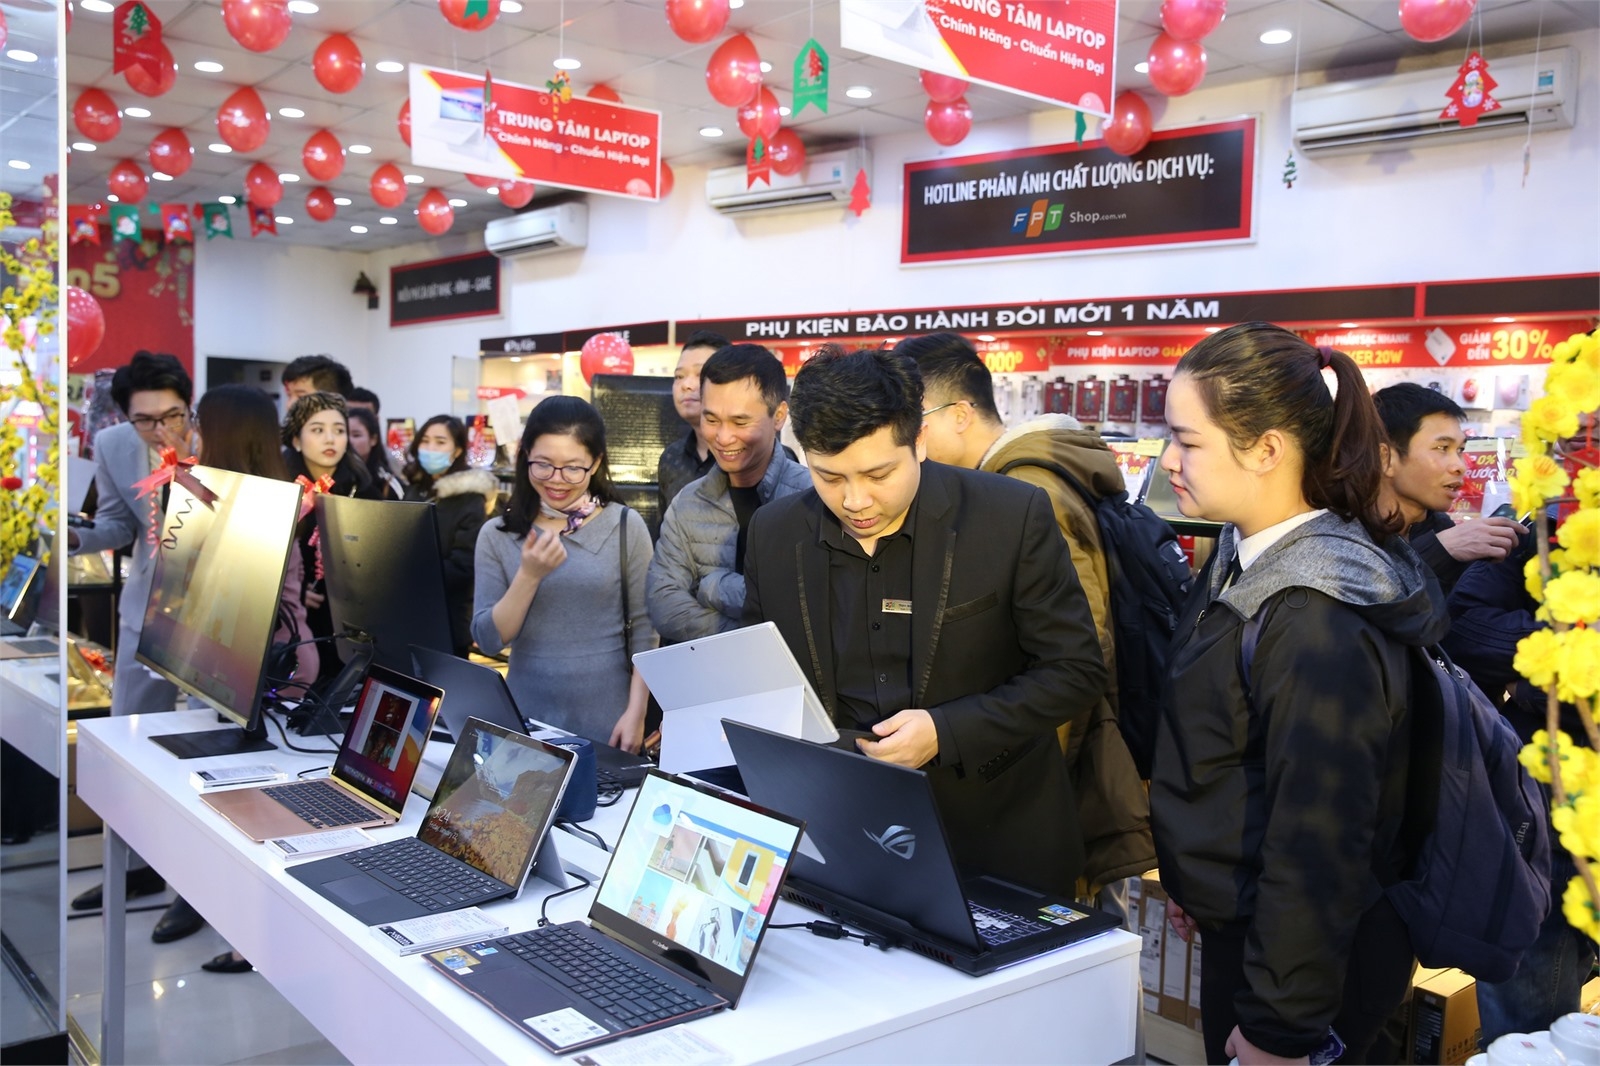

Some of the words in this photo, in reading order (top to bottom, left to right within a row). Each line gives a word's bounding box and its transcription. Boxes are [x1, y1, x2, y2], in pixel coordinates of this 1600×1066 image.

[1005, 4, 1042, 31] TÂM
[1047, 17, 1106, 49] LAPTOP
[940, 15, 976, 36] Chính
[979, 26, 1011, 49] Hãng
[1020, 39, 1058, 60] Chuẩn
[1060, 51, 1084, 69] Hiện
[1086, 58, 1105, 76] Đại
[498, 110, 553, 132] TRUNG
[556, 119, 590, 138] TÂM
[594, 127, 650, 149] LAPTOP
[498, 131, 531, 146] Chính
[570, 144, 605, 158] Chuẩn
[607, 150, 630, 164] Hiện
[632, 155, 650, 167] Đại
[924, 180, 977, 205] HOTLINE
[979, 172, 1017, 198] PHẢN
[1019, 171, 1050, 194] ÁNH
[1052, 162, 1090, 191] CHẤT
[1091, 161, 1143, 189] LƯỢNG
[1146, 156, 1183, 184] DỊCH
[1186, 153, 1215, 180] VỤ:
[746, 321, 790, 338] PHỤ
[796, 318, 849, 337] KIỆN
[856, 314, 908, 332] BẢO
[915, 310, 989, 329] HÀNH
[1054, 303, 1111, 324] MỚI
[1121, 304, 1134, 321] 1
[1147, 299, 1220, 320] NĂM
[1067, 347, 1089, 360] PHỤ
[1091, 344, 1116, 360] KIỆN
[1118, 346, 1160, 358] LAPTOP
[1459, 329, 1491, 345] GIẢM
[1466, 343, 1490, 360] ĐẾN
[1491, 329, 1553, 360] 30%
[1375, 349, 1403, 364] 20W
[1476, 454, 1497, 466] 0%
[433, 805, 451, 824] 9:24
